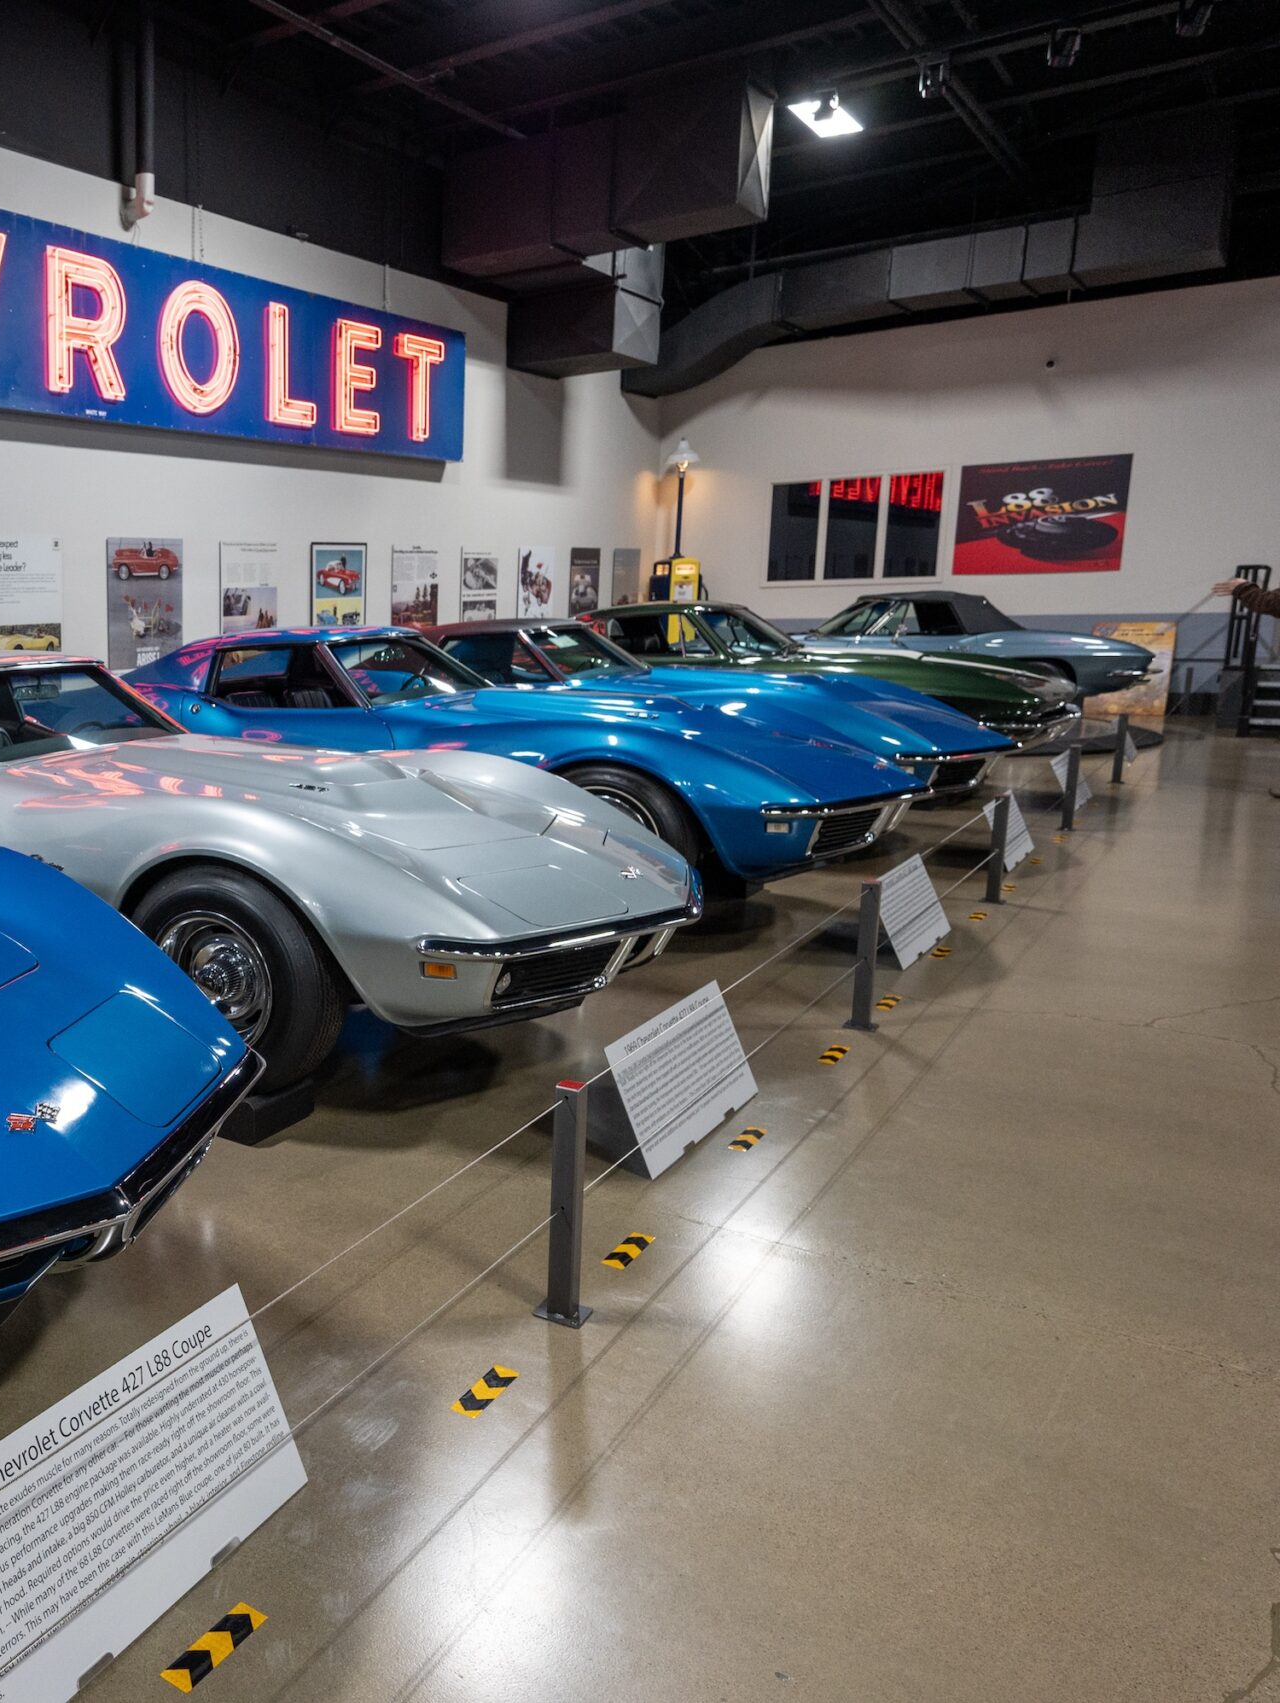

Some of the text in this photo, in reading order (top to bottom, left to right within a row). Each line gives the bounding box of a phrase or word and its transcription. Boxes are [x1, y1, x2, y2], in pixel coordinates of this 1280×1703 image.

[977, 493, 1119, 528] INVASION
[8, 1482, 36, 1507] exudes
[36, 1463, 62, 1487] muscle
[61, 1455, 73, 1468] for
[73, 1441, 94, 1461] many
[92, 1425, 119, 1446] reasons.
[118, 1406, 141, 1427] Totally
[140, 1380, 175, 1412] redesigned
[56, 1386, 120, 1440] Corvette
[118, 1364, 147, 1397] 427
[145, 1347, 172, 1378] L88
[170, 1323, 213, 1361] Coupe
[1, 1567, 26, 1591] heads
[26, 1552, 42, 1572] and
[41, 1537, 67, 1560] intake,
[67, 1531, 73, 1540] a
[71, 1521, 86, 1536] big
[84, 1507, 99, 1526] 850
[98, 1495, 115, 1515] CFM
[114, 1481, 137, 1503] Holley
[136, 1457, 171, 1486] carburetor,
[170, 1442, 183, 1460] and
[2, 1586, 27, 1610] hood.
[26, 1556, 62, 1591] Required
[62, 1536, 90, 1564] options
[90, 1515, 112, 1541] would
[111, 1504, 130, 1523] drive
[129, 1494, 142, 1509] the
[142, 1481, 159, 1502] price
[159, 1468, 175, 1486] even
[174, 1454, 196, 1473] higher,
[10, 1522, 58, 1568] performance
[59, 1496, 92, 1527] upgrades
[93, 1476, 120, 1501] making
[118, 1462, 137, 1481] them
[137, 1436, 171, 1467] race-ready
[170, 1422, 186, 1441] right
[21, 1520, 36, 1536] the
[34, 1507, 50, 1526] 427
[49, 1496, 64, 1515] L88
[64, 1480, 89, 1504] engine
[89, 1459, 118, 1488] package
[117, 1449, 131, 1464] was
[130, 1429, 160, 1454] available.
[158, 1412, 181, 1432] Highly
[30, 1481, 63, 1510] Corvette
[62, 1473, 74, 1487] for
[74, 1463, 88, 1479] any
[87, 1449, 107, 1469] other
[10, 1600, 35, 1625] While
[34, 1583, 57, 1606] many
[56, 1573, 65, 1588] of
[64, 1565, 78, 1581] the
[76, 1553, 89, 1568] '68
[87, 1543, 102, 1562] L88
[101, 1519, 134, 1551] Corvettes
[134, 1506, 151, 1525] were
[150, 1489, 169, 1511] raced
[168, 1477, 184, 1497] right
[183, 1469, 193, 1484] off
[24, 1615, 42, 1634] This
[42, 1600, 60, 1620] may
[58, 1585, 78, 1605] have
[77, 1569, 97, 1590] been
[96, 1558, 110, 1574] the
[110, 1545, 126, 1563] case
[126, 1529, 142, 1550] with
[141, 1521, 155, 1537] this
[153, 1501, 179, 1526] LeMans
[178, 1489, 193, 1506] Blue
[193, 1475, 213, 1494] coupe,
